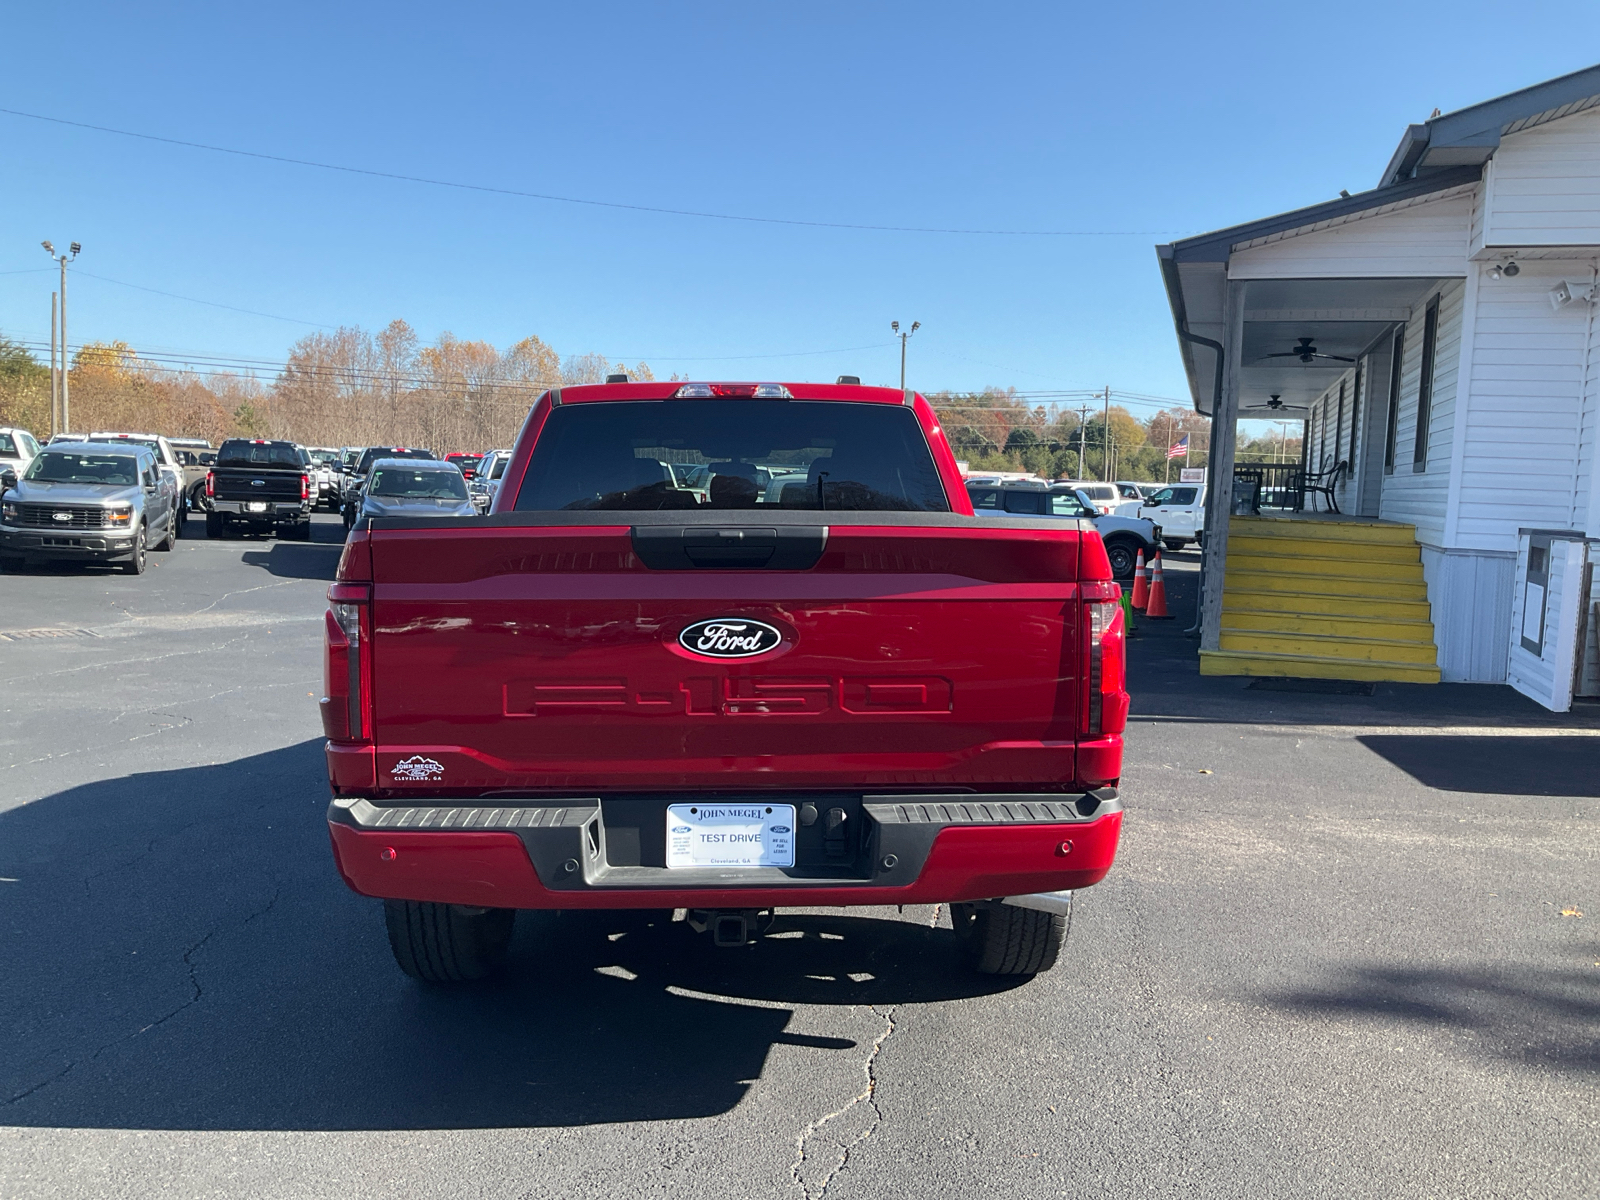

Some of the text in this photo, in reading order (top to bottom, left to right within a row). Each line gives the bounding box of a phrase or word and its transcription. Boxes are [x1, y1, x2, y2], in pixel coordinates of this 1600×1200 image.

[697, 623, 763, 650] Ford
[503, 677, 954, 717] F-150
[698, 809, 764, 821] JOHN MEGEL
[700, 834, 761, 843] TEST DRIVE
